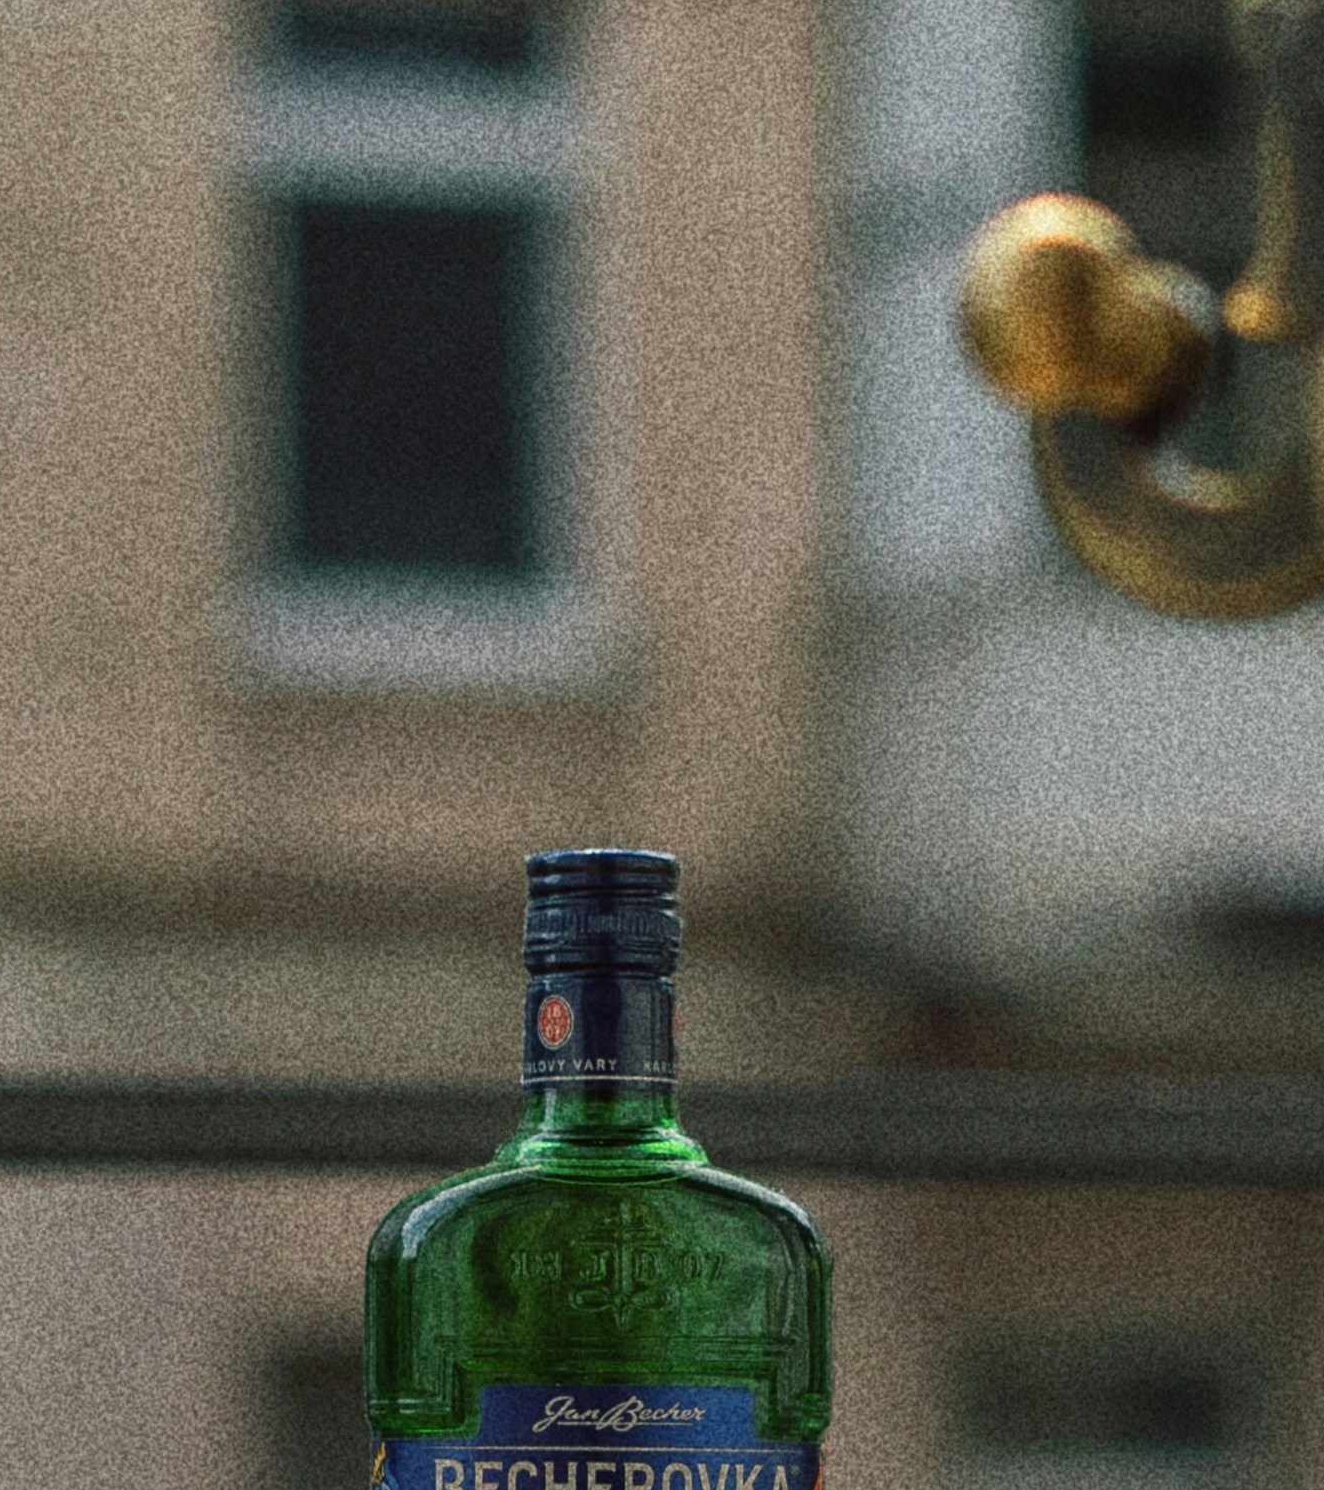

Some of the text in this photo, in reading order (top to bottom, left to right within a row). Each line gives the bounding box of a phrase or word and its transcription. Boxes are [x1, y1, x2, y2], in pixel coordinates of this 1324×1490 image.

[572, 1057, 617, 1071] VARY
[532, 1395, 707, 1433] Jan Becher
